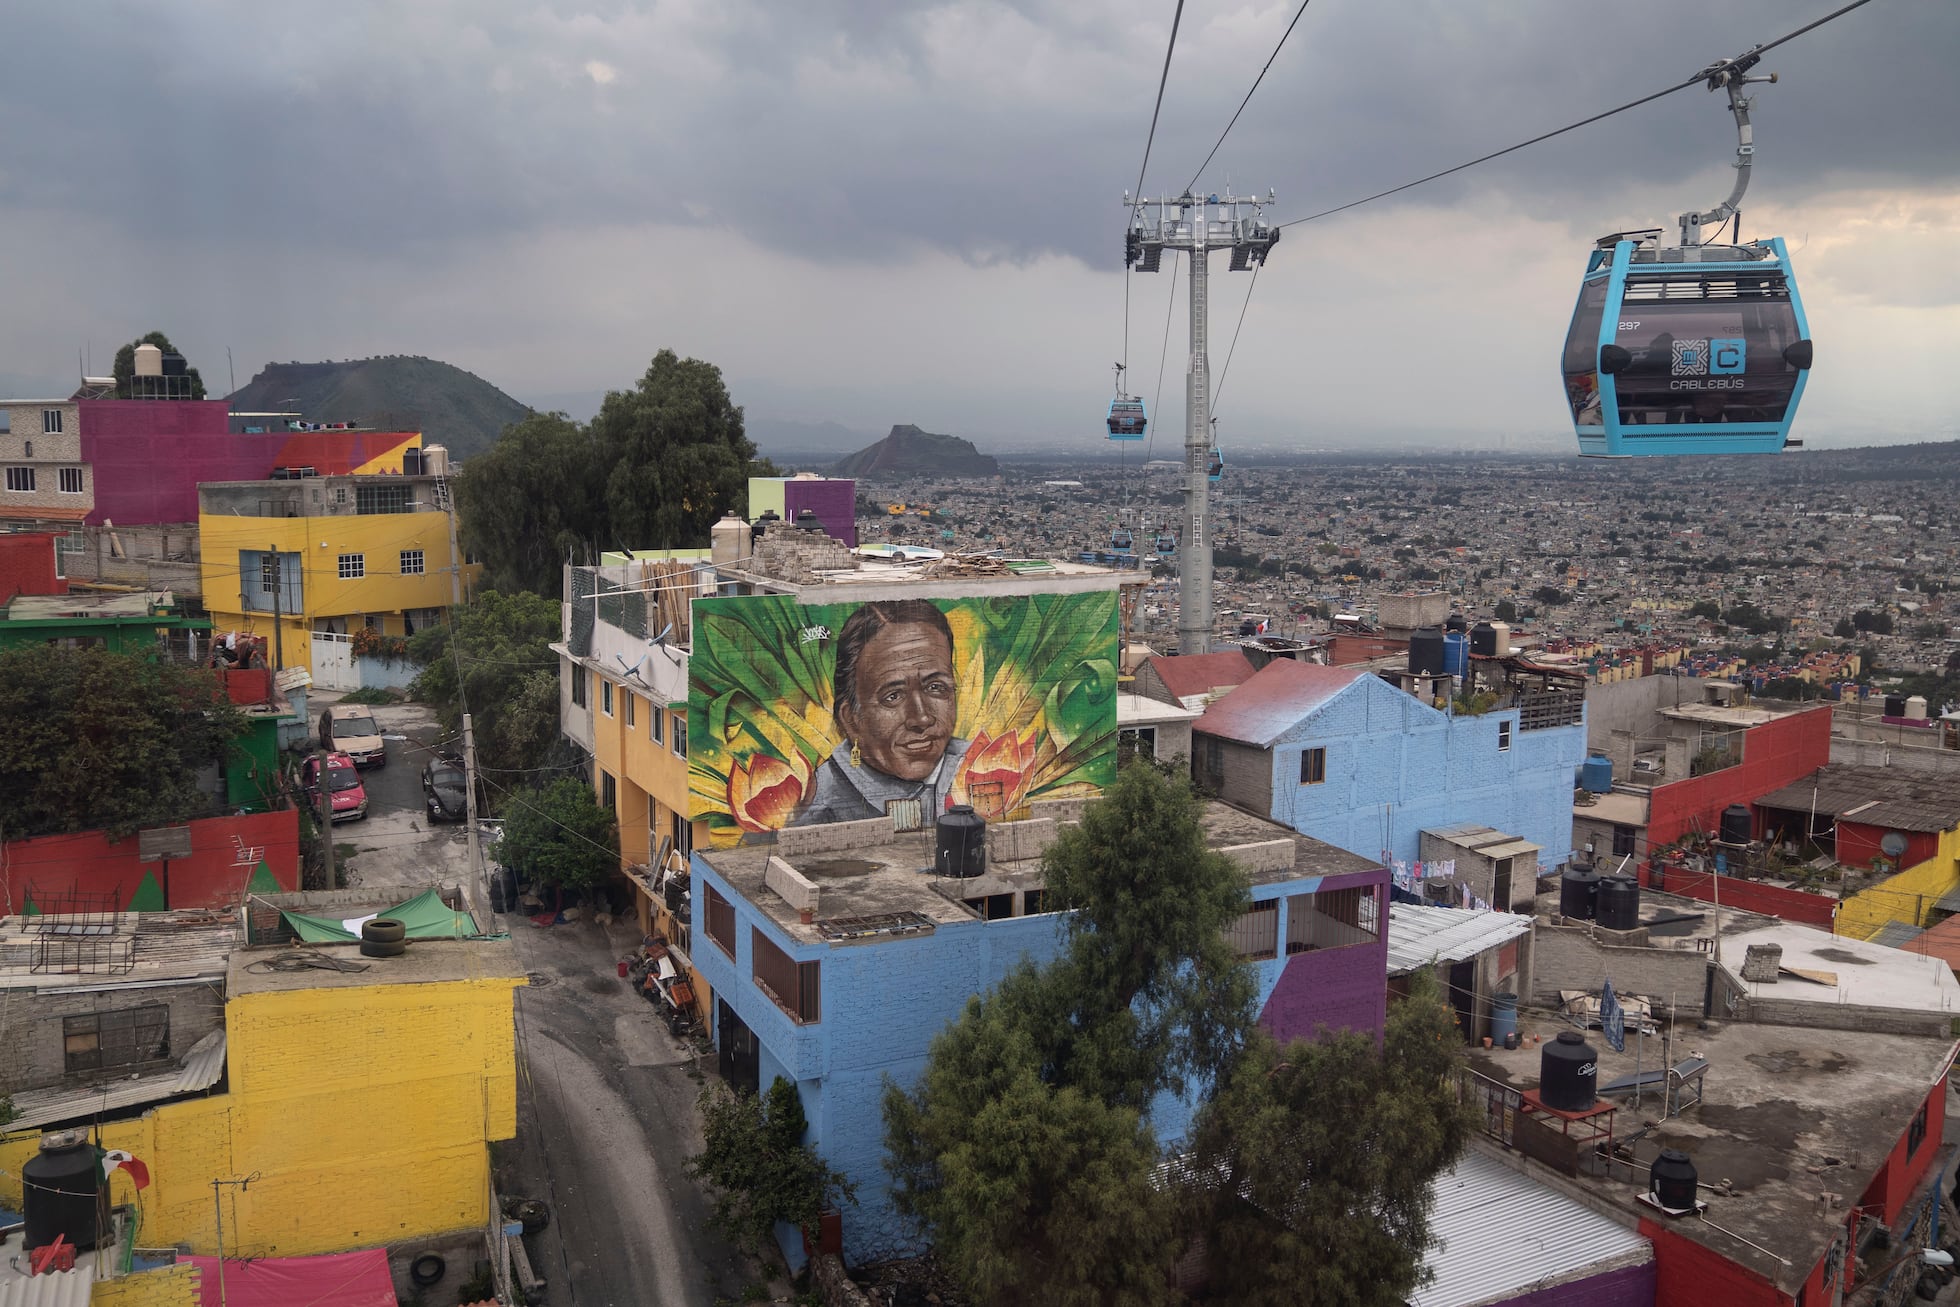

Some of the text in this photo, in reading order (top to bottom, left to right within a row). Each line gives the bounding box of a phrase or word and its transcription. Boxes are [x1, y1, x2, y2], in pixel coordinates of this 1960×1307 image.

[1618, 321, 1640, 330] 297
[1717, 348, 1739, 368] C
[1670, 376, 1744, 390] CABLEBÚS
